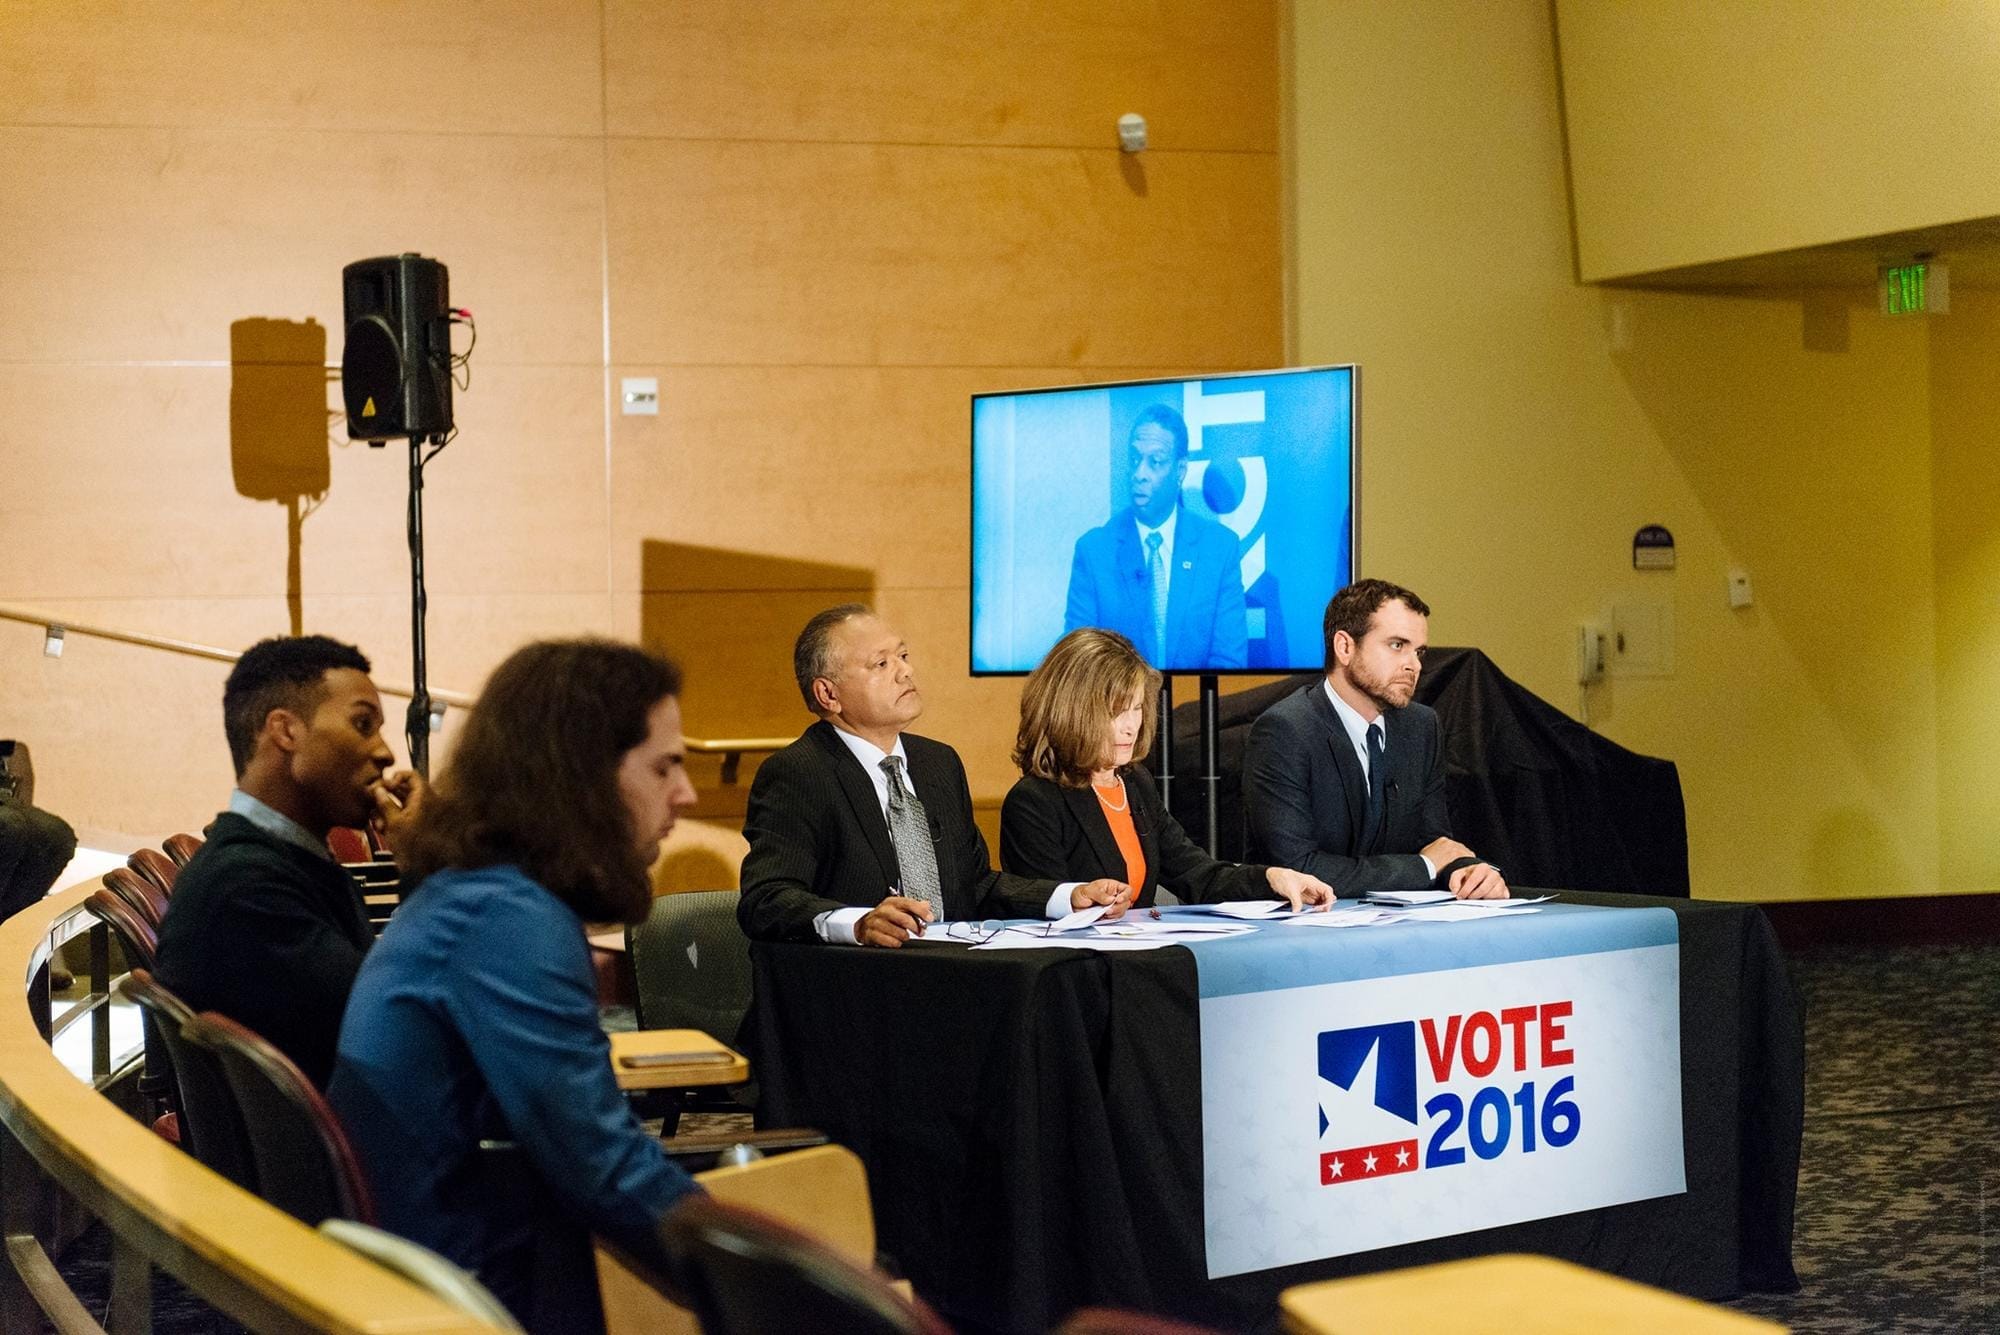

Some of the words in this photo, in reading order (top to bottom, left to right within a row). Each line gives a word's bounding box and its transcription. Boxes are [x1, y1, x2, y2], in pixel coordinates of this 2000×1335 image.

[1888, 265, 1925, 314] EXIT
[1419, 1000, 1575, 1083] VOTE
[1424, 1075, 1581, 1169] 2016
